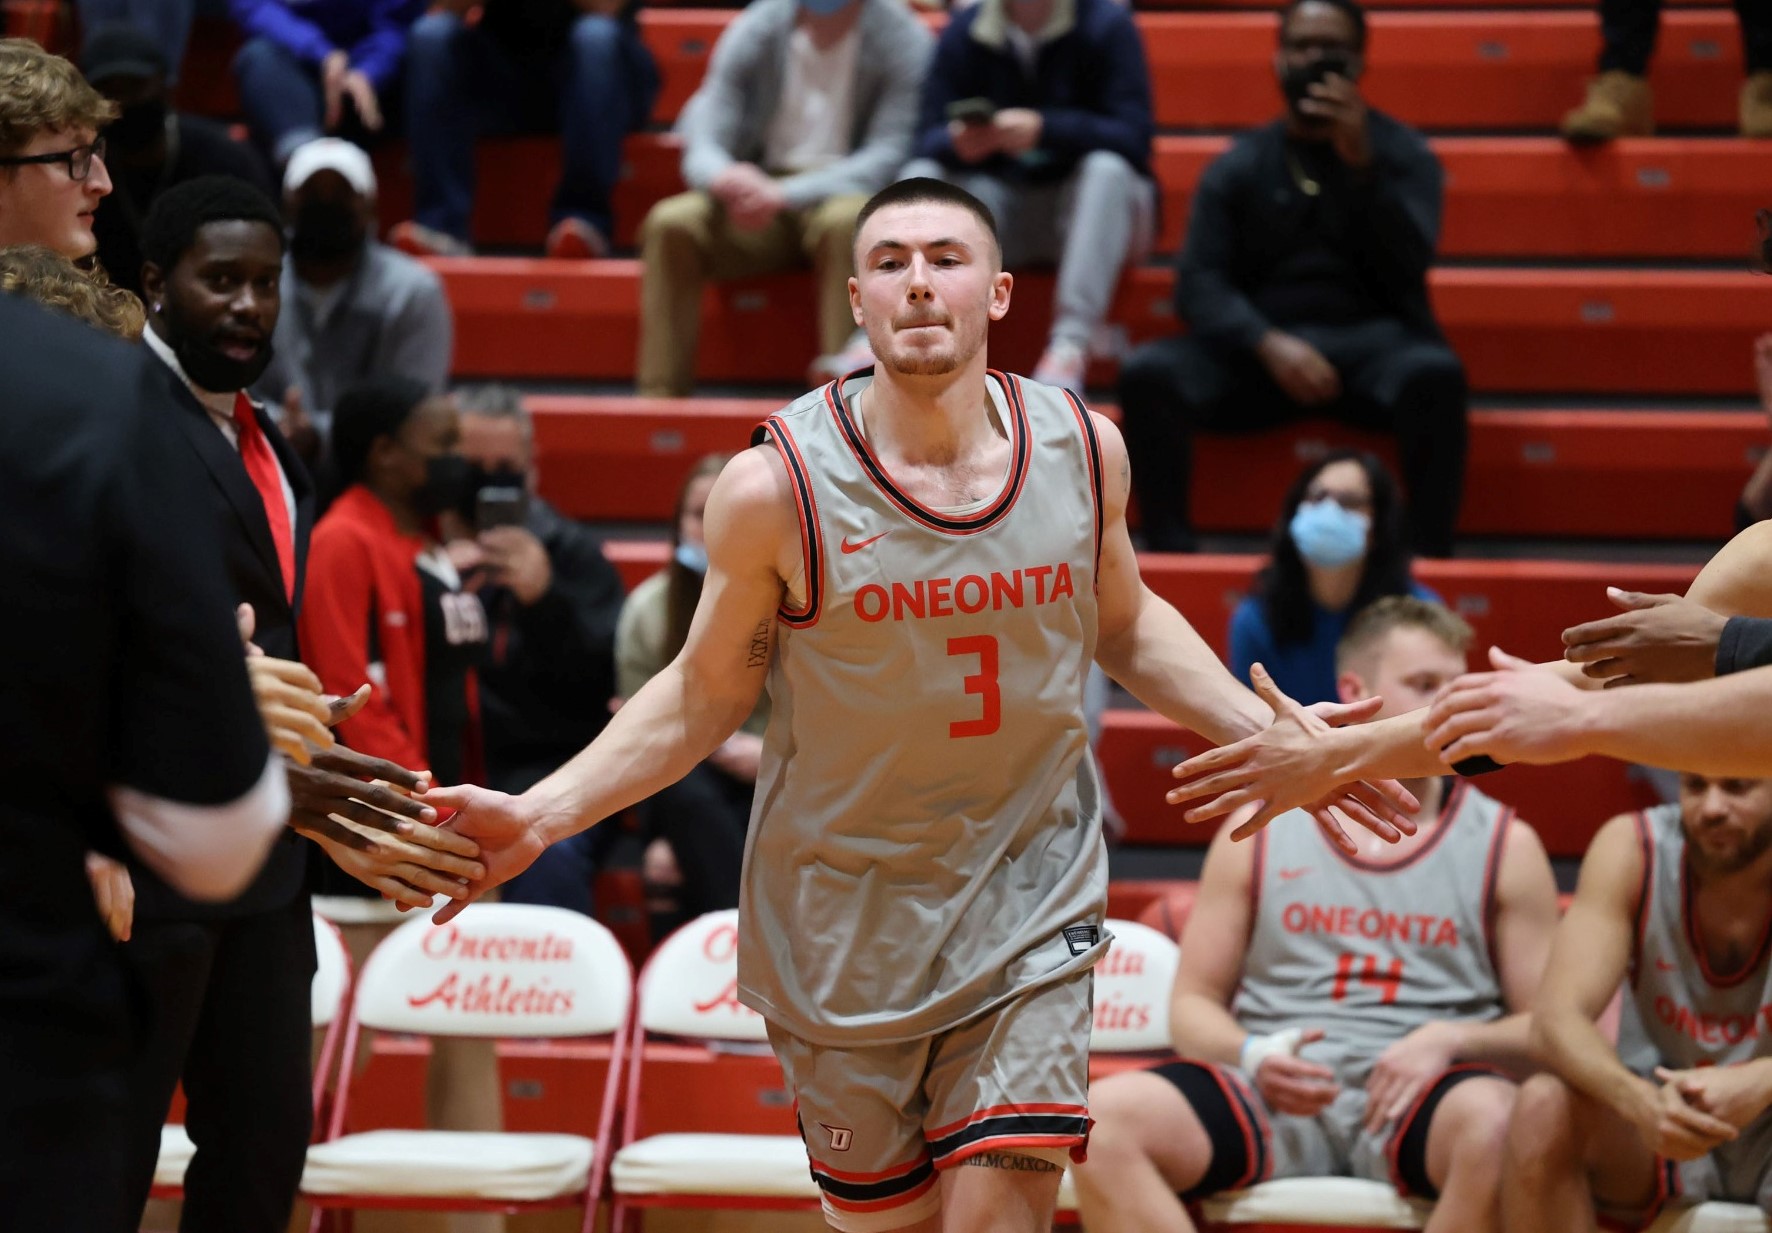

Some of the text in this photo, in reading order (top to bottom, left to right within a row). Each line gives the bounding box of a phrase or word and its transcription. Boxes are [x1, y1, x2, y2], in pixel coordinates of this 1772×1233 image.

[854, 562, 1074, 623] ONEONTA
[947, 634, 1001, 739] 3
[421, 923, 574, 961] Oneonta
[1281, 901, 1459, 949] ONEONTA
[408, 971, 576, 1016] Athletics
[1331, 951, 1405, 1005] 14
